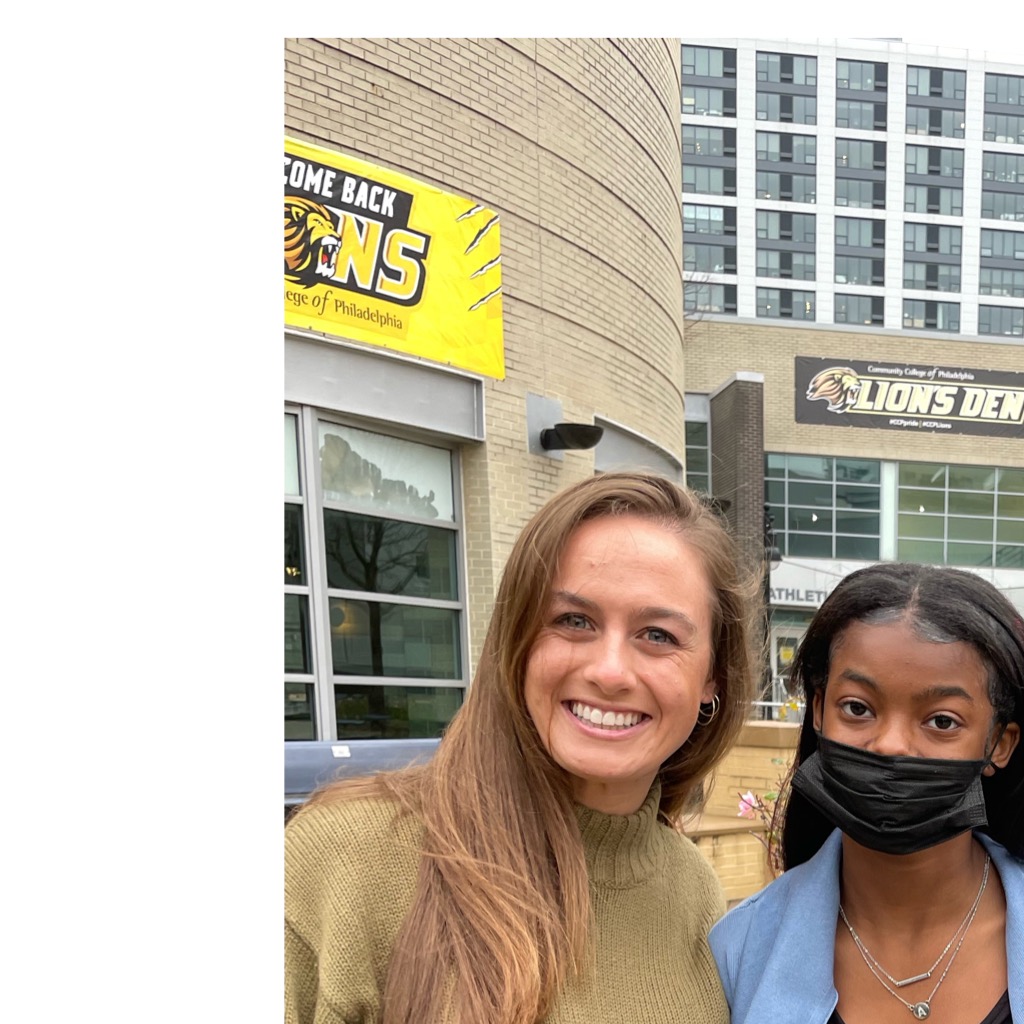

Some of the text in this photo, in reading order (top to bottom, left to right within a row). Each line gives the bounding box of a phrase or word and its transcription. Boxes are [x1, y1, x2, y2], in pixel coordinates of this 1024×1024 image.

[341, 176, 397, 218] BACK
[312, 290, 333, 316] of
[334, 298, 402, 330] Philadelphia
[867, 365, 975, 380] Community College of Philadelphia
[918, 1006, 927, 1017] A
